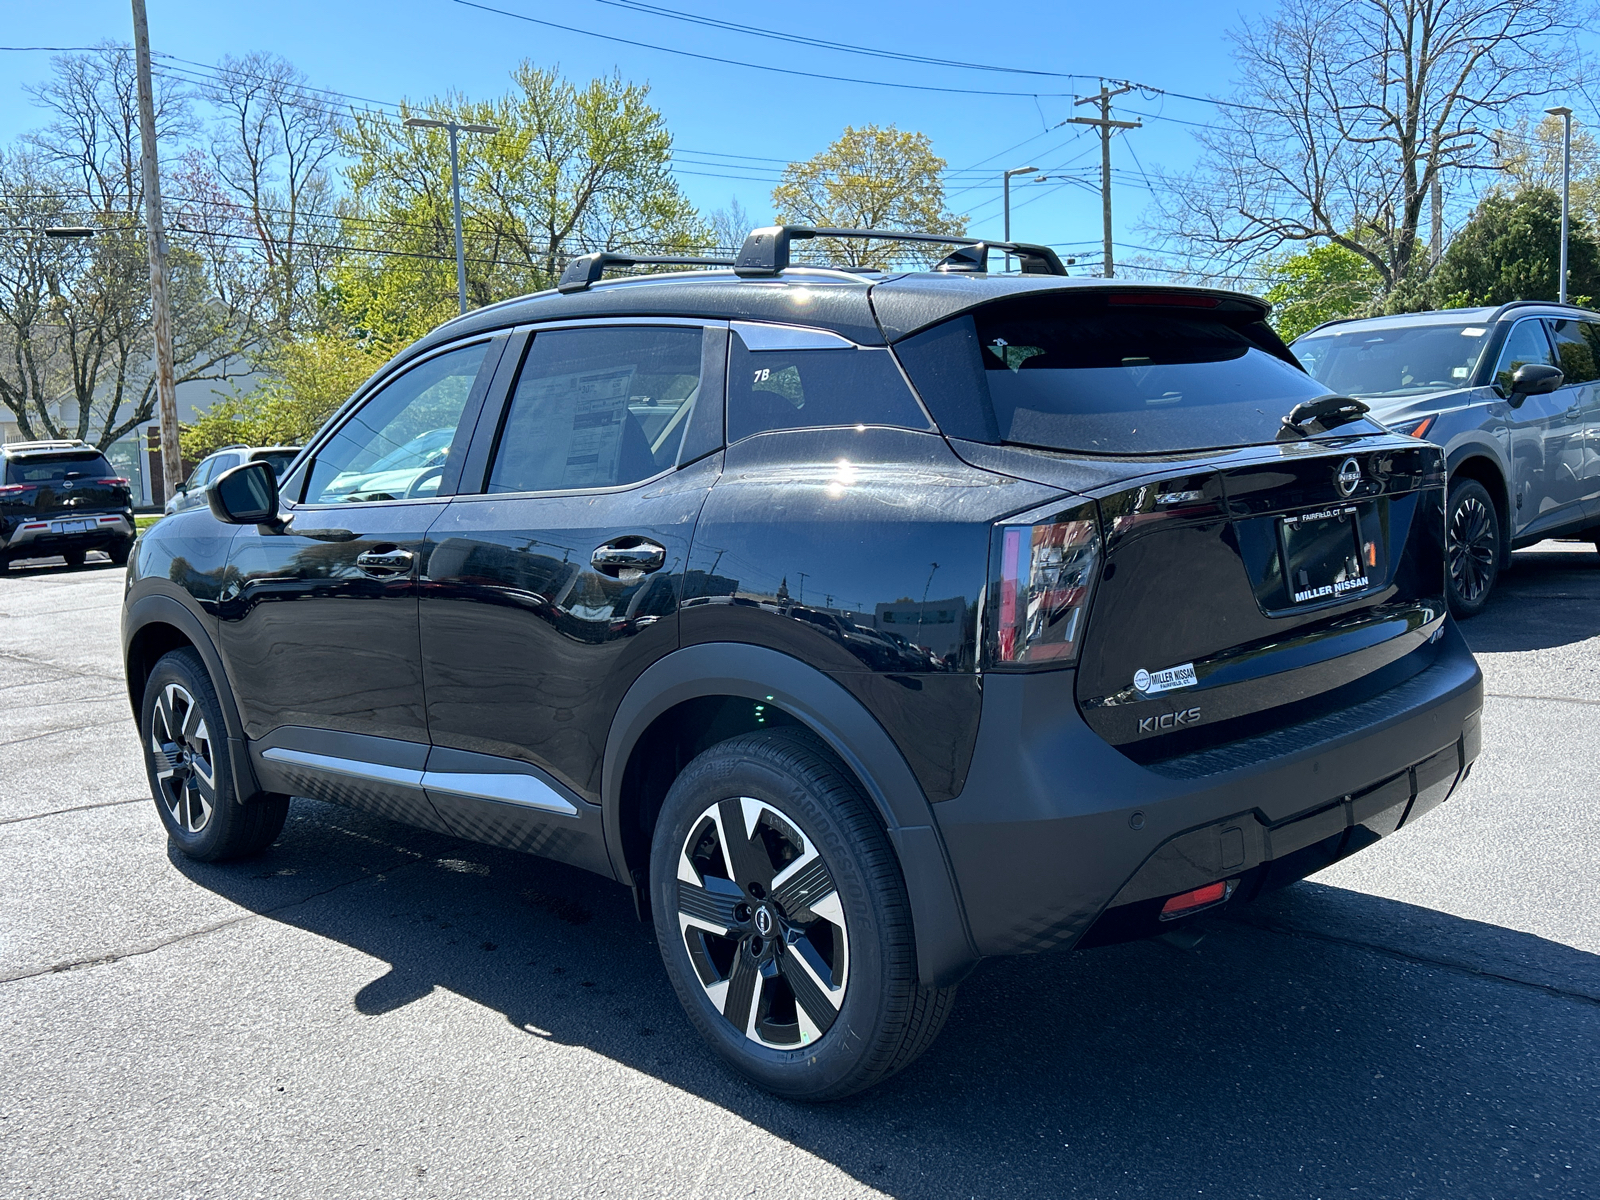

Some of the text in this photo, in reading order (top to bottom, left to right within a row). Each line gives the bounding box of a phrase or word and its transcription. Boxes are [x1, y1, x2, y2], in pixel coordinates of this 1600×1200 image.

[753, 368, 770, 383] 7B
[1294, 576, 1369, 602] MILLER NISSAN
[1151, 667, 1196, 686] MILLER NISSAN
[1138, 707, 1201, 733] KICKS
[788, 786, 872, 930] BRIDGESTONE
